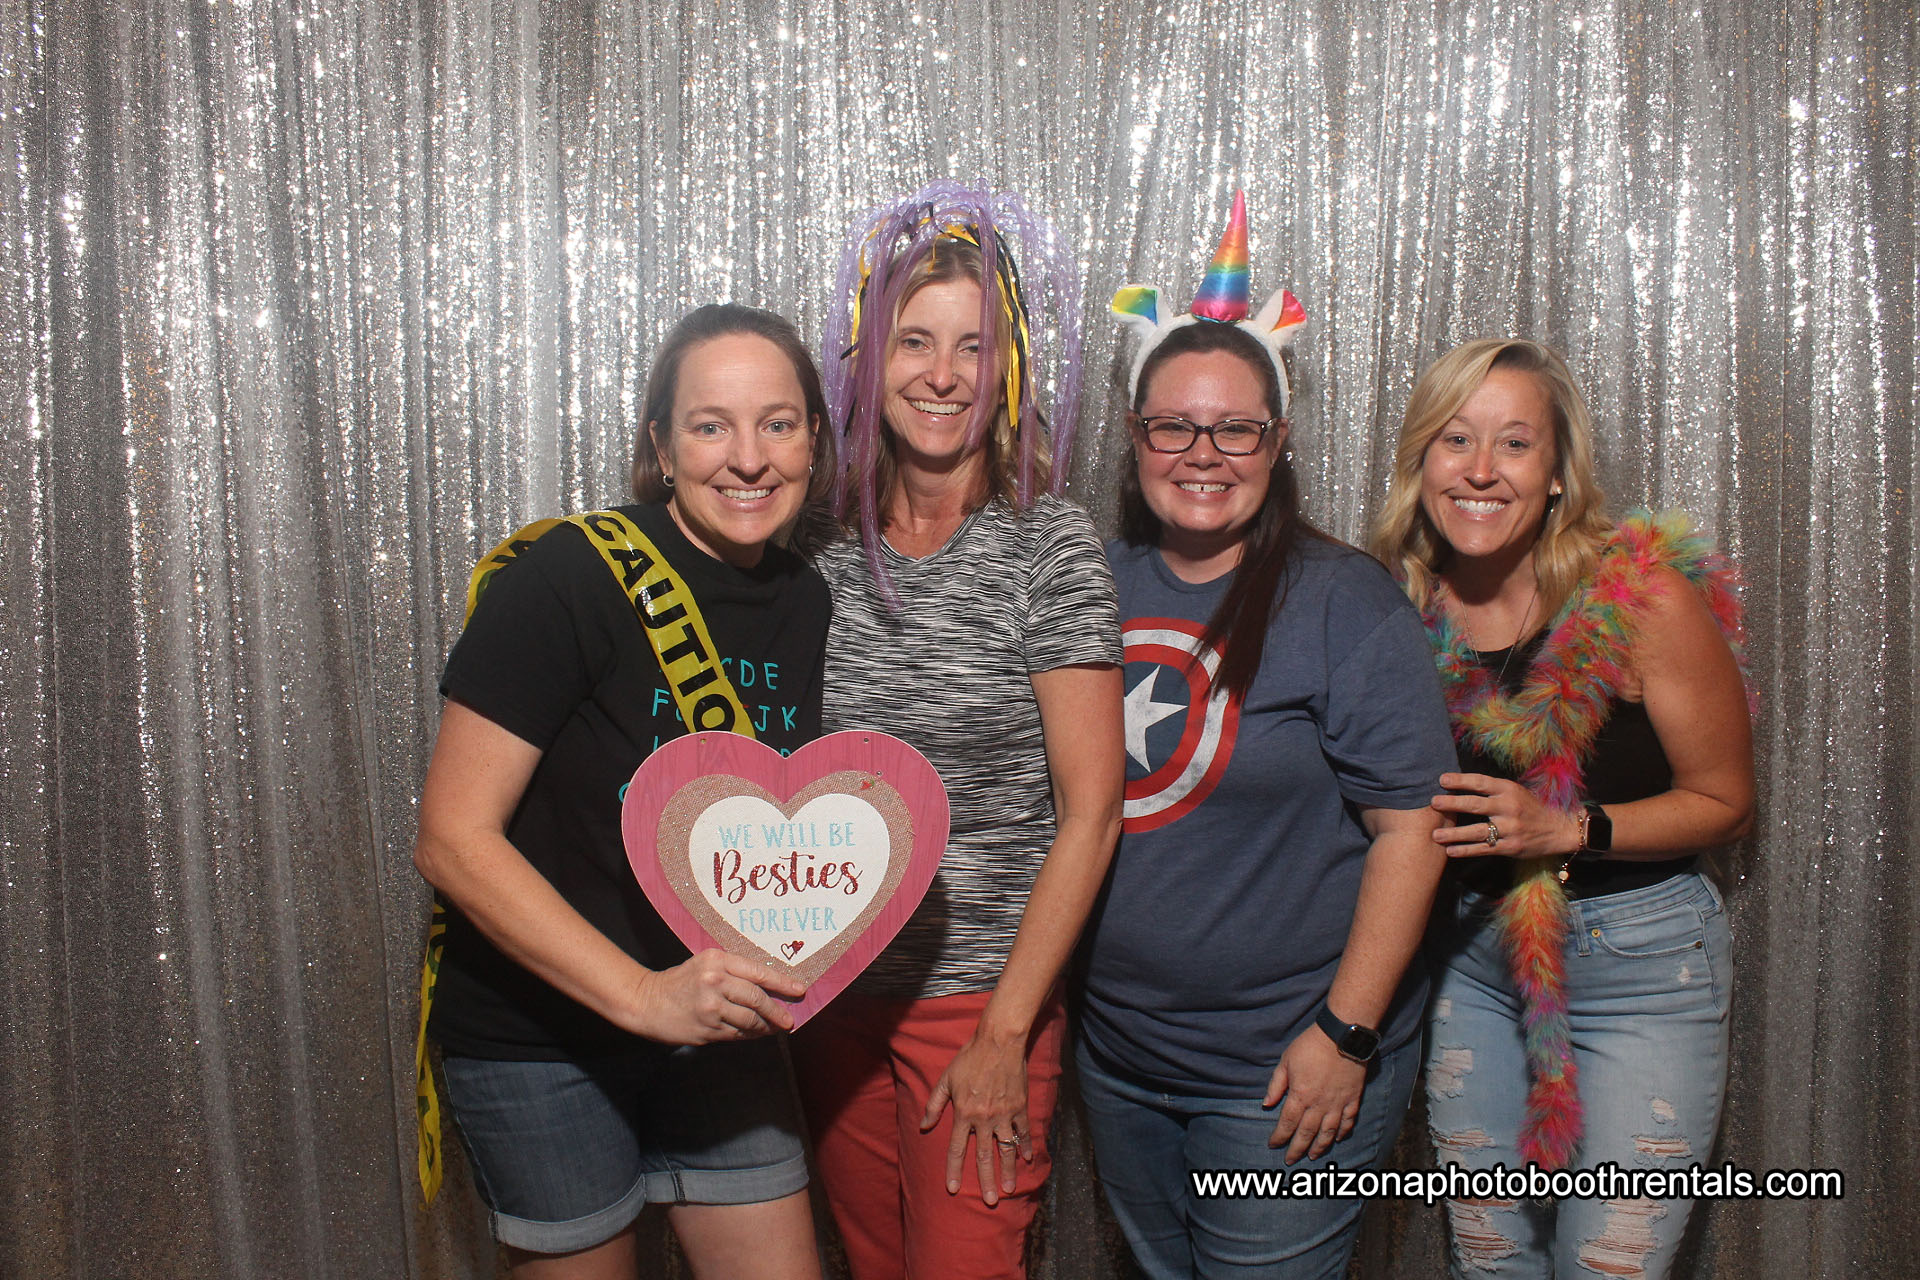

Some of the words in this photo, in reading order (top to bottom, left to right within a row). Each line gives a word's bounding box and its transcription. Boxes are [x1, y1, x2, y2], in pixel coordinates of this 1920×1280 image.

[718, 824, 754, 849] WE
[761, 823, 822, 848] WILL
[829, 822, 857, 847] BE
[713, 849, 864, 904] Besties
[738, 906, 838, 933] FOREVER
